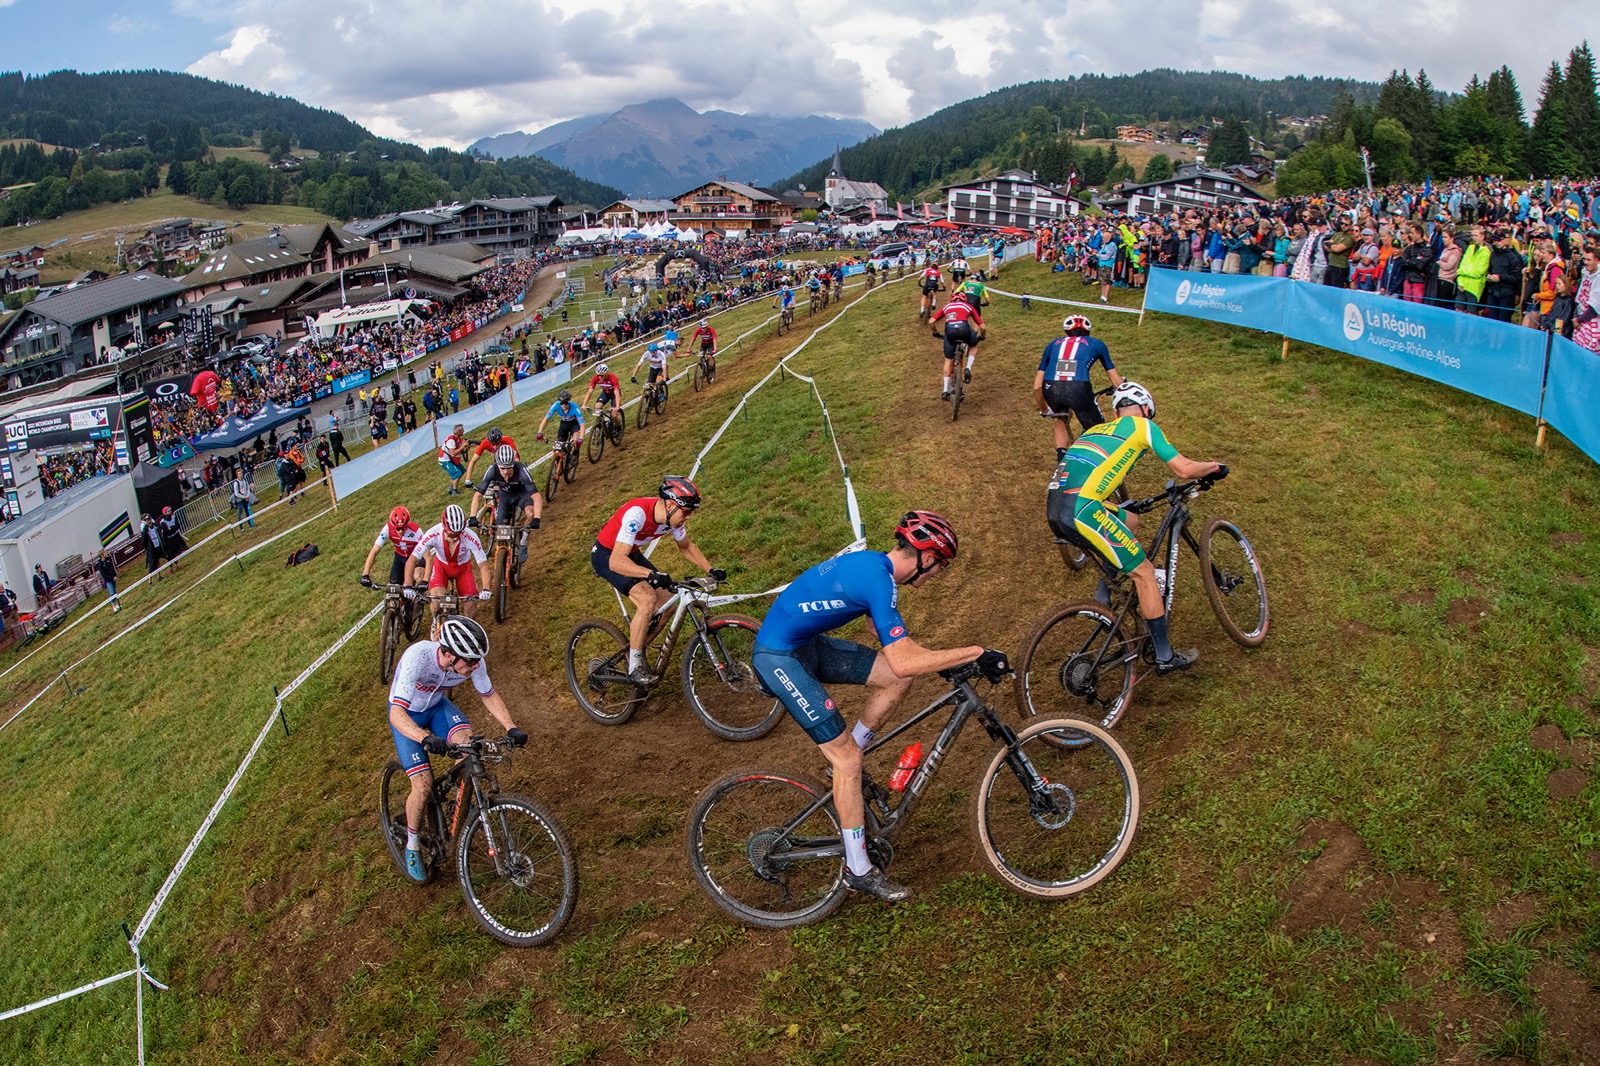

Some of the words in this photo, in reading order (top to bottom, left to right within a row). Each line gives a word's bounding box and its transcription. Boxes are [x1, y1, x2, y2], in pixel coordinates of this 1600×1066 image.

[1192, 283, 1201, 293] La
[1202, 284, 1226, 298] Région
[1366, 309, 1382, 328] La
[1383, 314, 1427, 341] Région
[1367, 330, 1462, 369] Auvergne-Rhône-Alpes
[151, 392, 185, 404] OAKLEY
[9, 425, 26, 438] UCI
[172, 445, 188, 459] CIC
[1095, 466, 1116, 495] SOUTH
[1114, 447, 1137, 474] AFRICA
[1092, 509, 1118, 534] SOUTH
[1114, 528, 1140, 556] AFRICA
[1168, 543, 1179, 611] cannondale
[798, 600, 832, 613] TCI
[485, 742, 498, 753] 24
[996, 863, 1027, 888] BARZO
